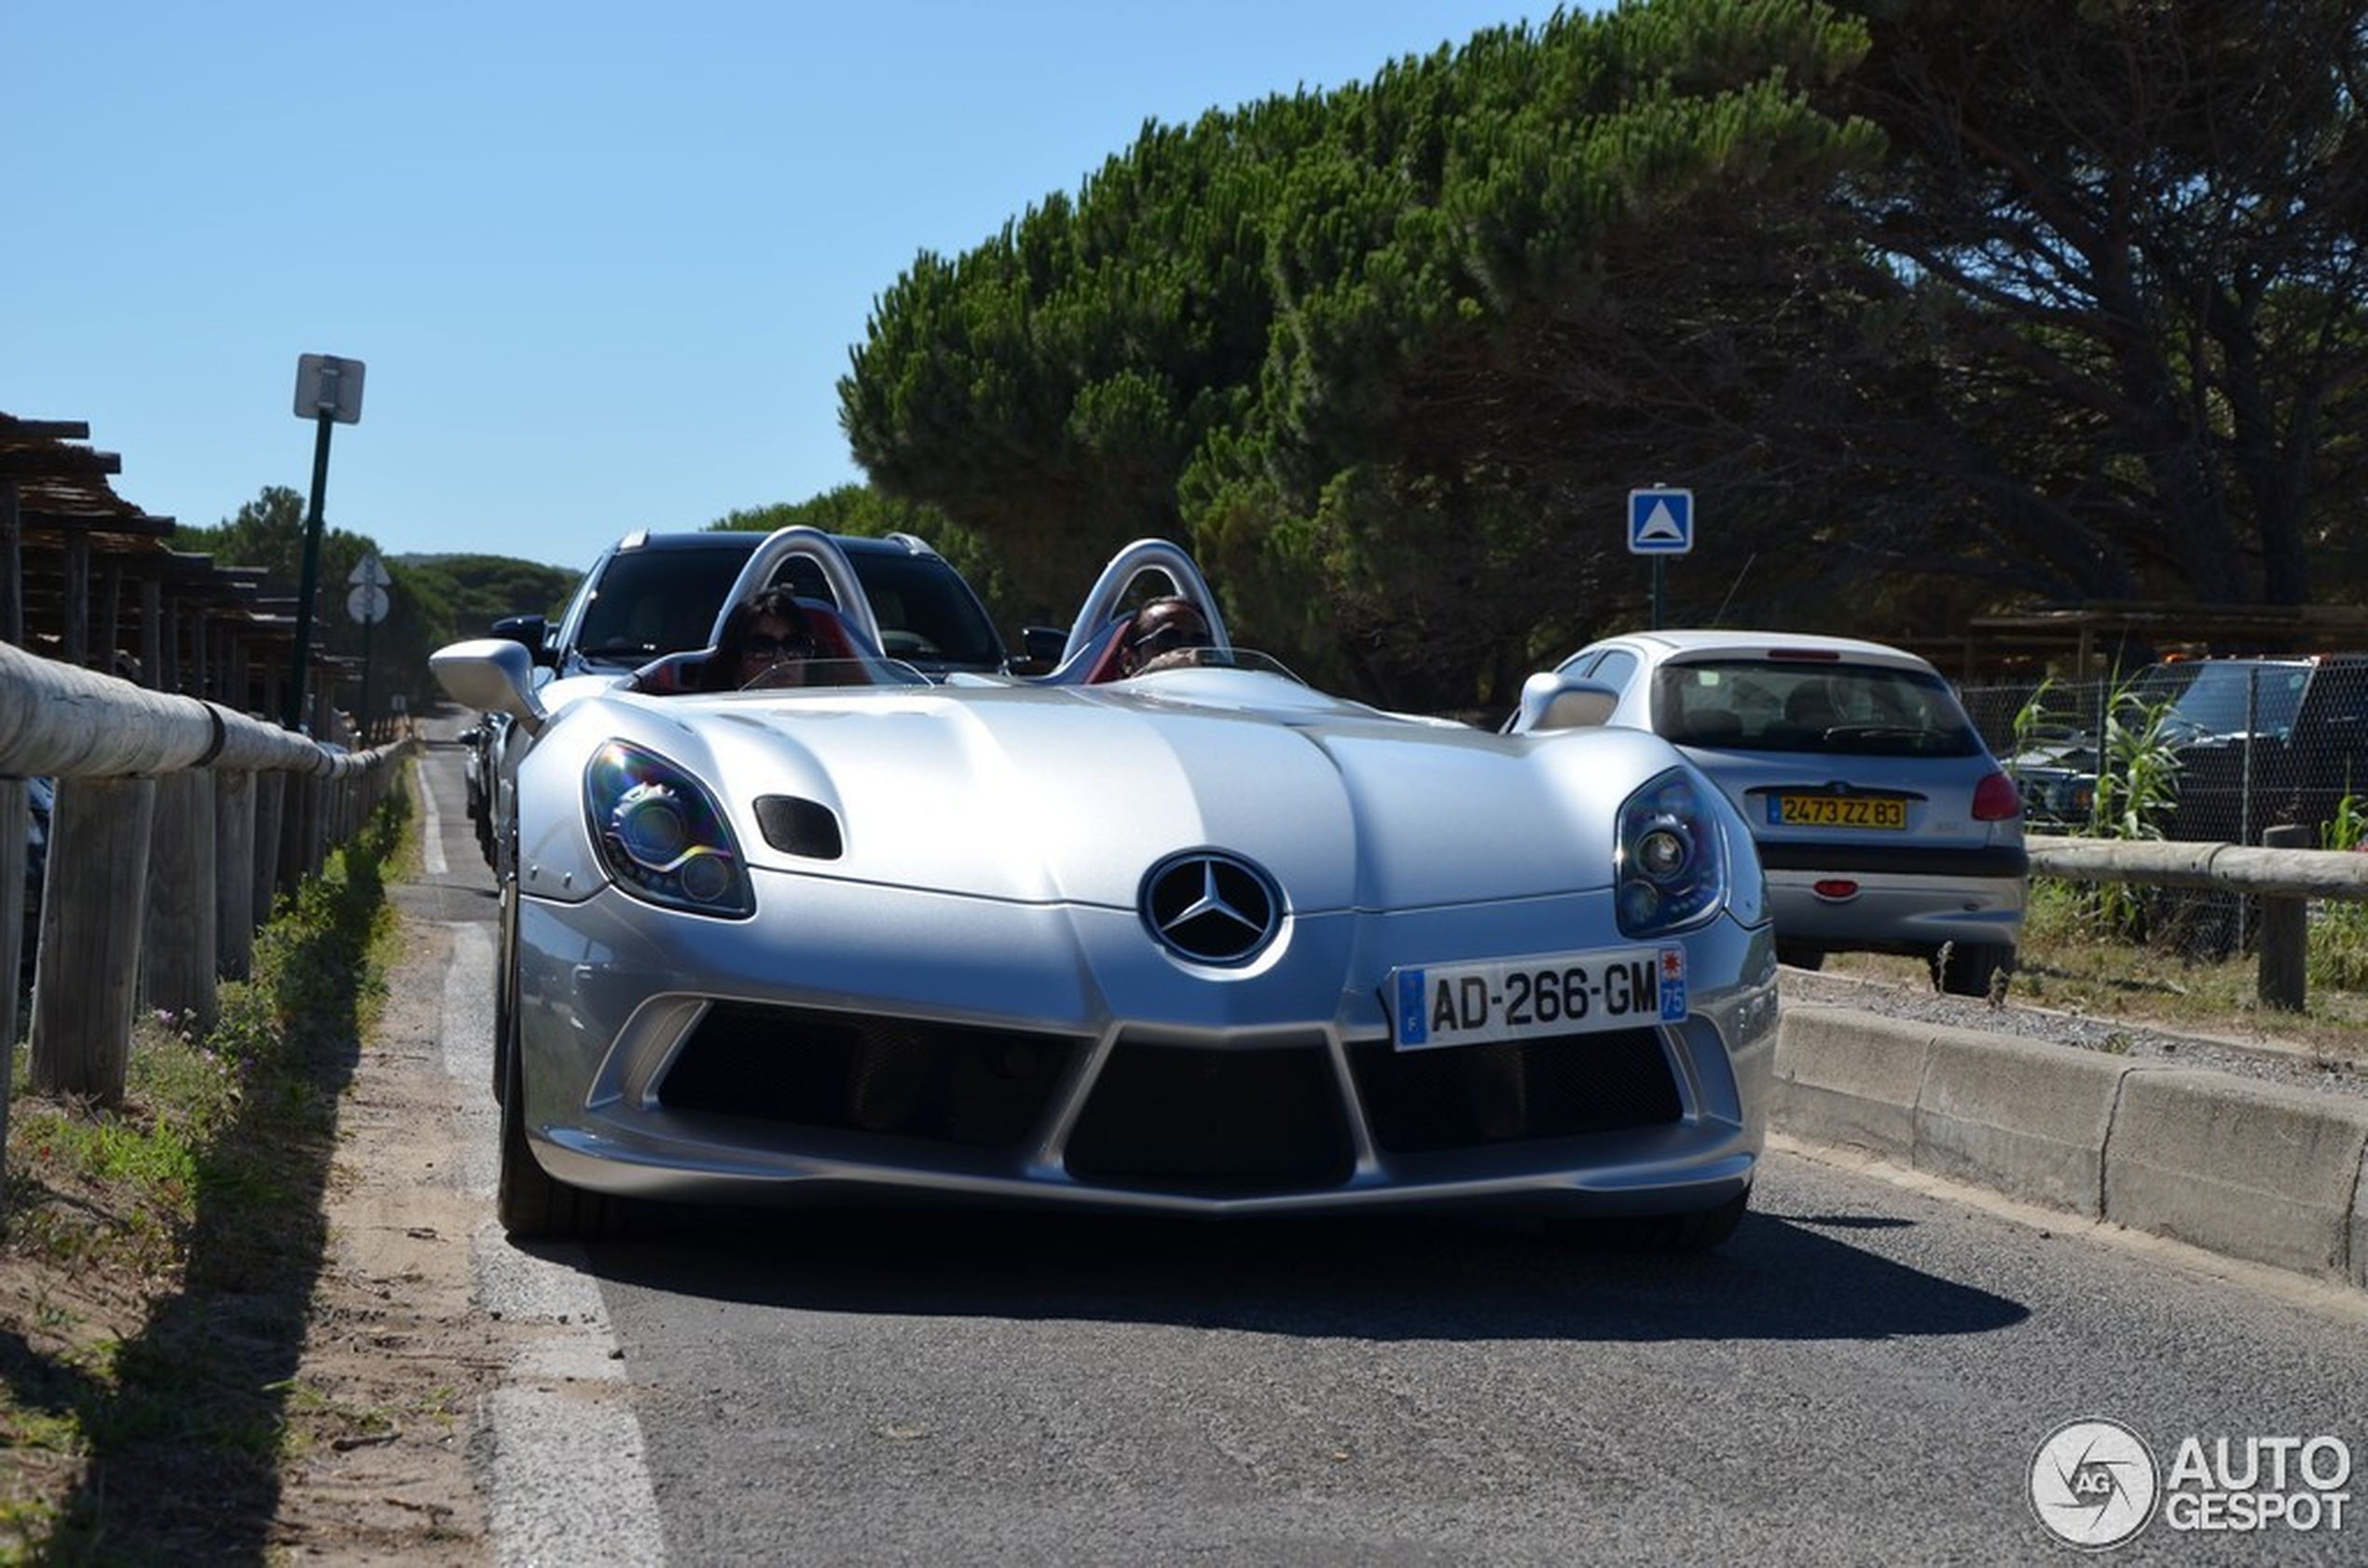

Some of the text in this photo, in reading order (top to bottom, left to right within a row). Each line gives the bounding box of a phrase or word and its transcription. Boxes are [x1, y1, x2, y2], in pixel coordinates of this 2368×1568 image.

[1783, 798, 1901, 825] 2473 ZZ 83
[1432, 960, 1658, 1032] AD-266-GM
[1663, 988, 1685, 1013] 75
